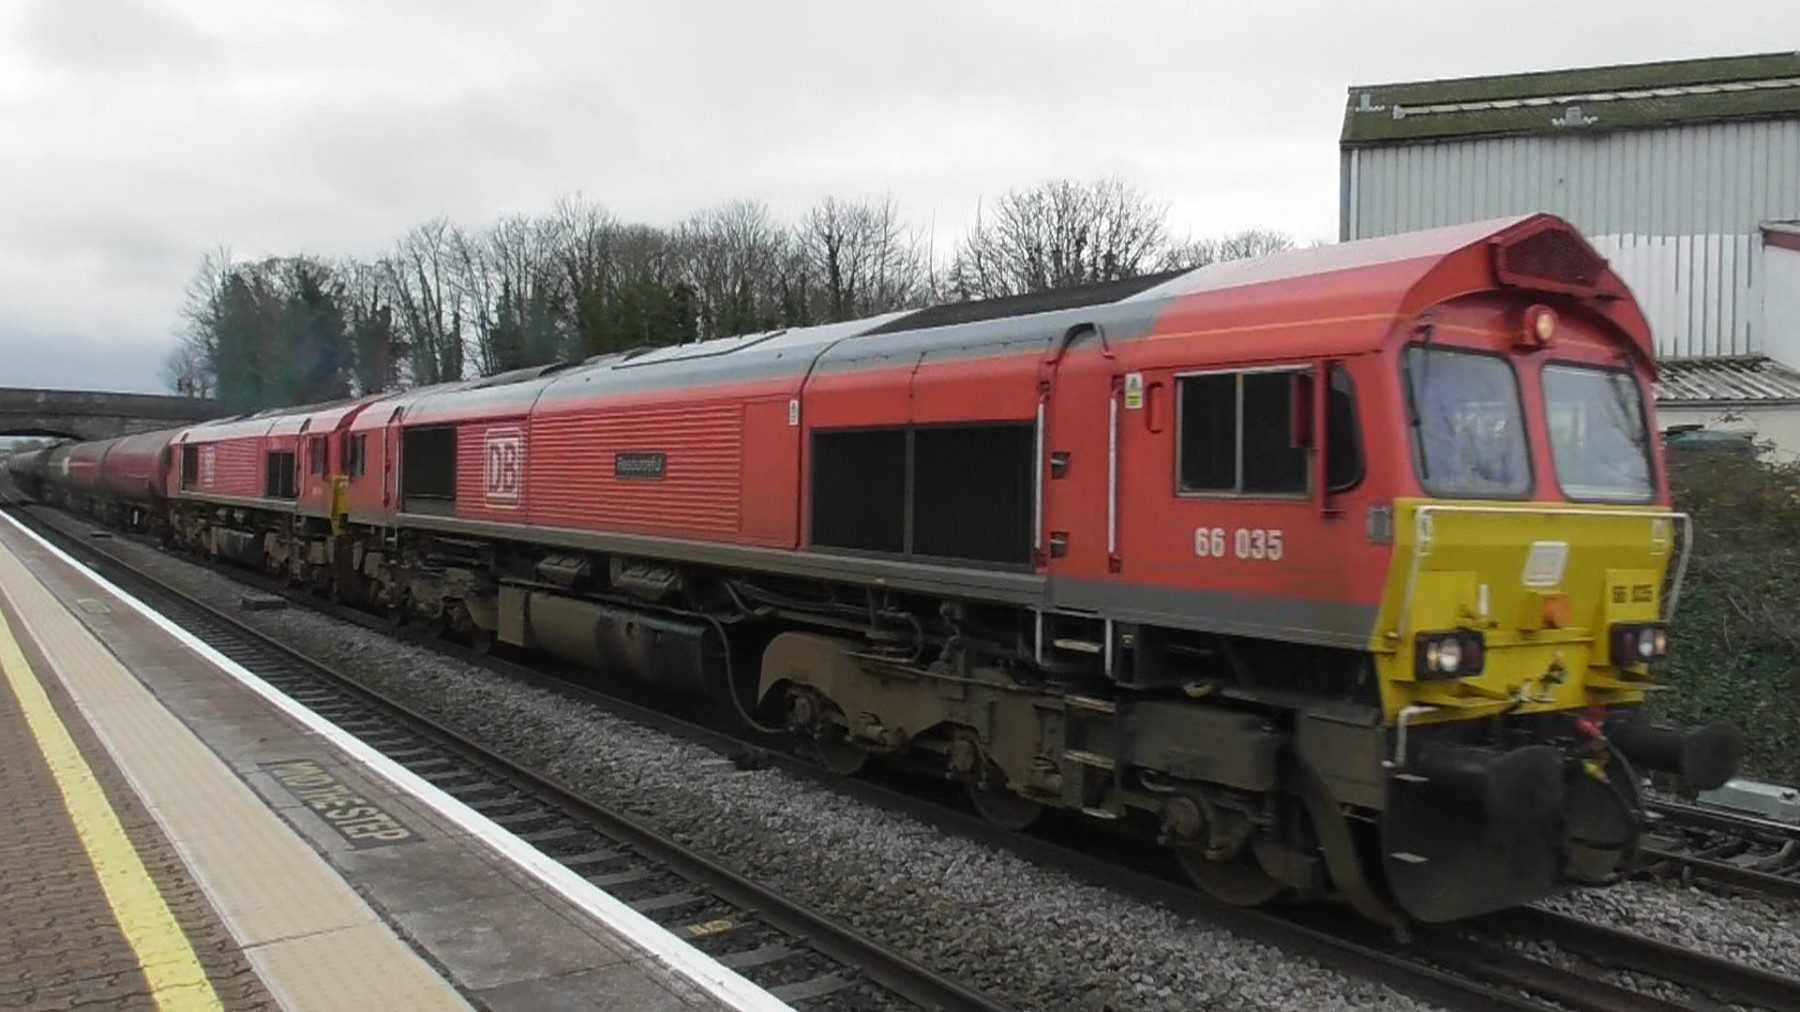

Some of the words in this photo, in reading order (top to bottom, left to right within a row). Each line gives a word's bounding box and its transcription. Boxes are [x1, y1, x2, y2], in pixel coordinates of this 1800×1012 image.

[485, 436, 520, 498] DB
[1195, 527, 1225, 557] 66
[1235, 528, 1283, 560] 035
[326, 806, 410, 840] STEP
